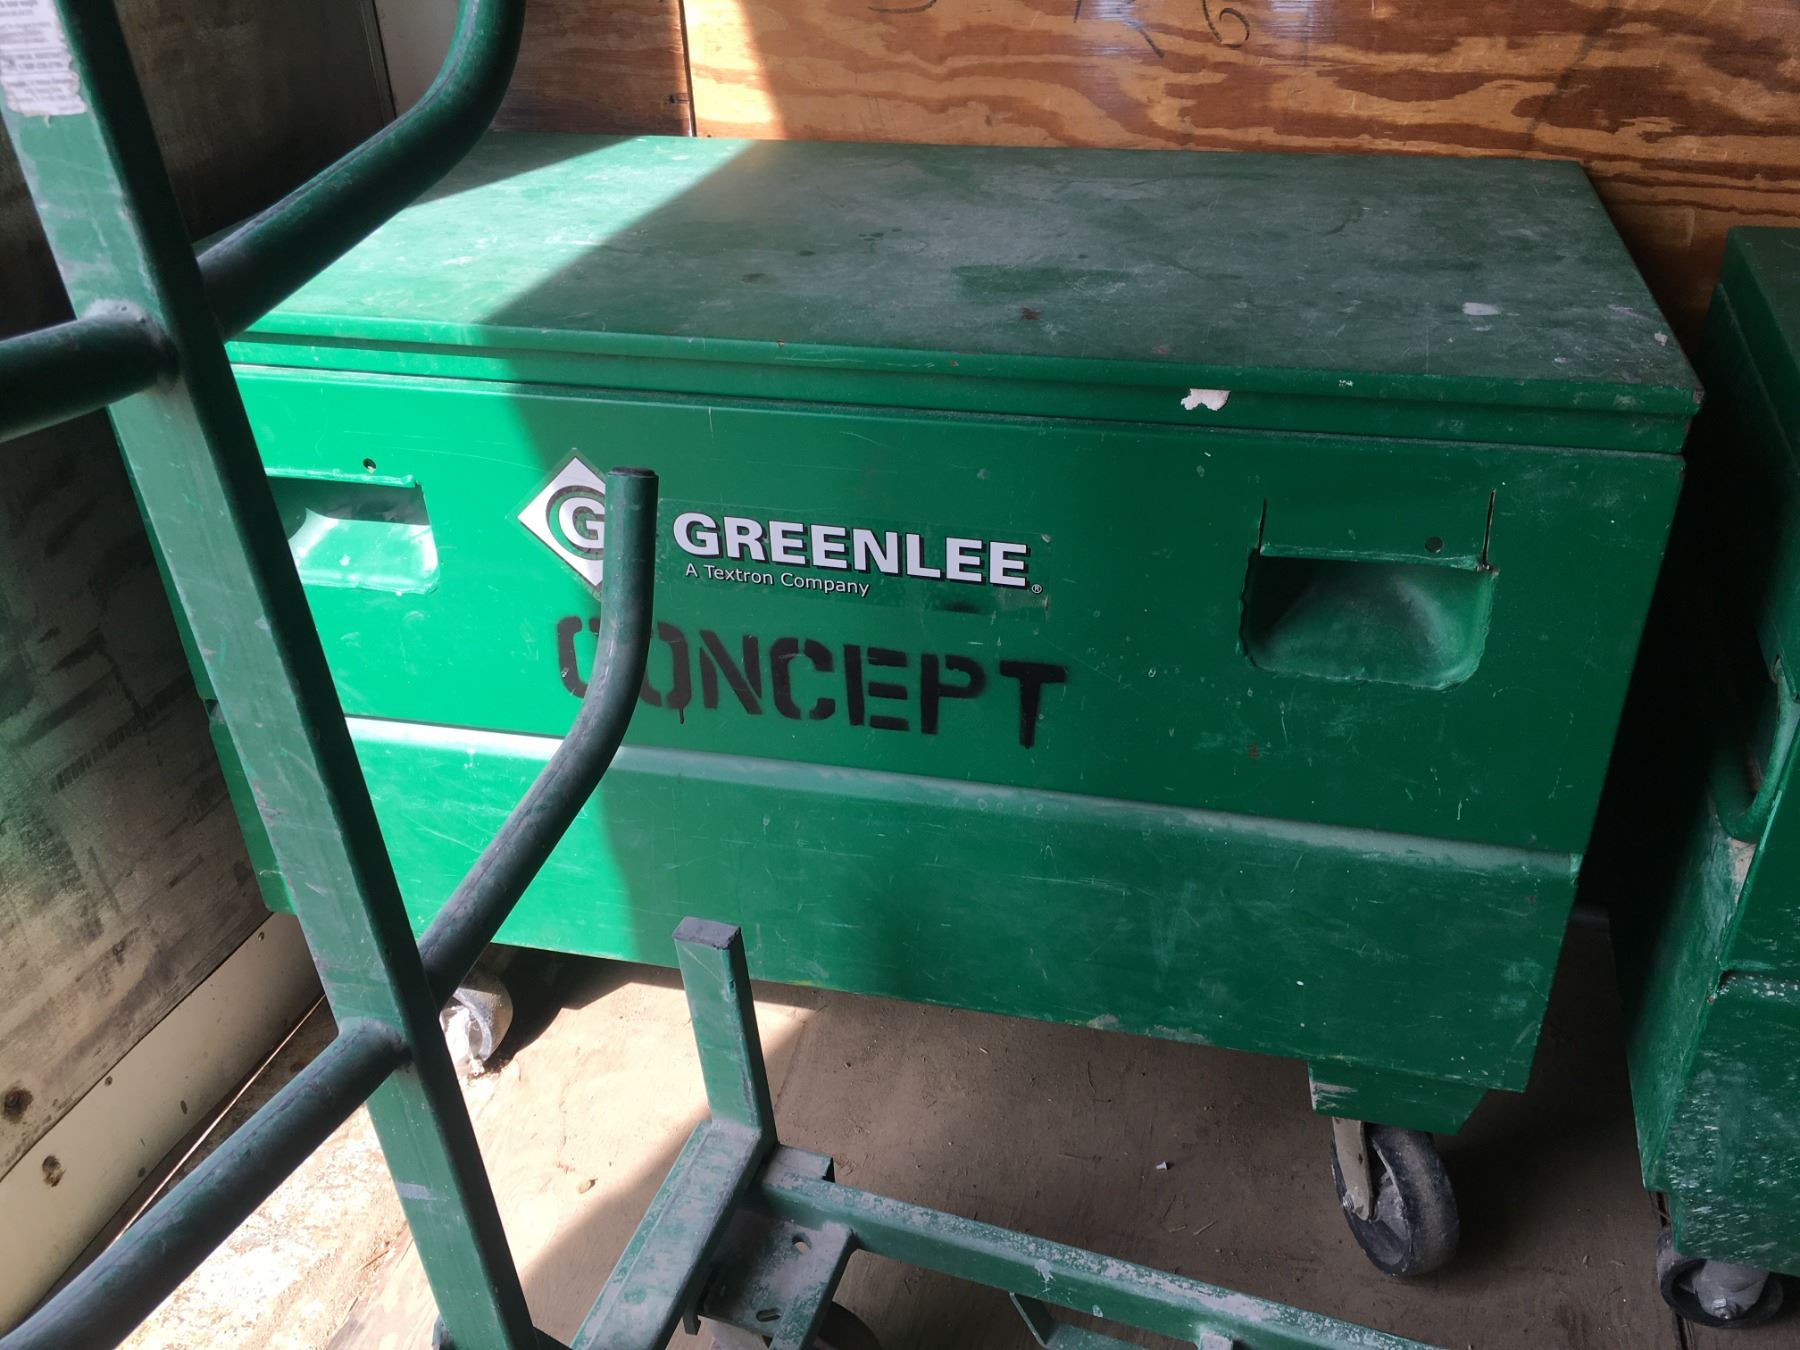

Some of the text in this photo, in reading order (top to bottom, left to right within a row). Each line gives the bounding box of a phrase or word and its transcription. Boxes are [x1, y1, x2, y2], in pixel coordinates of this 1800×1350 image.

[672, 512, 1030, 588] GREENLEE
[685, 562, 870, 599] A Textron Company
